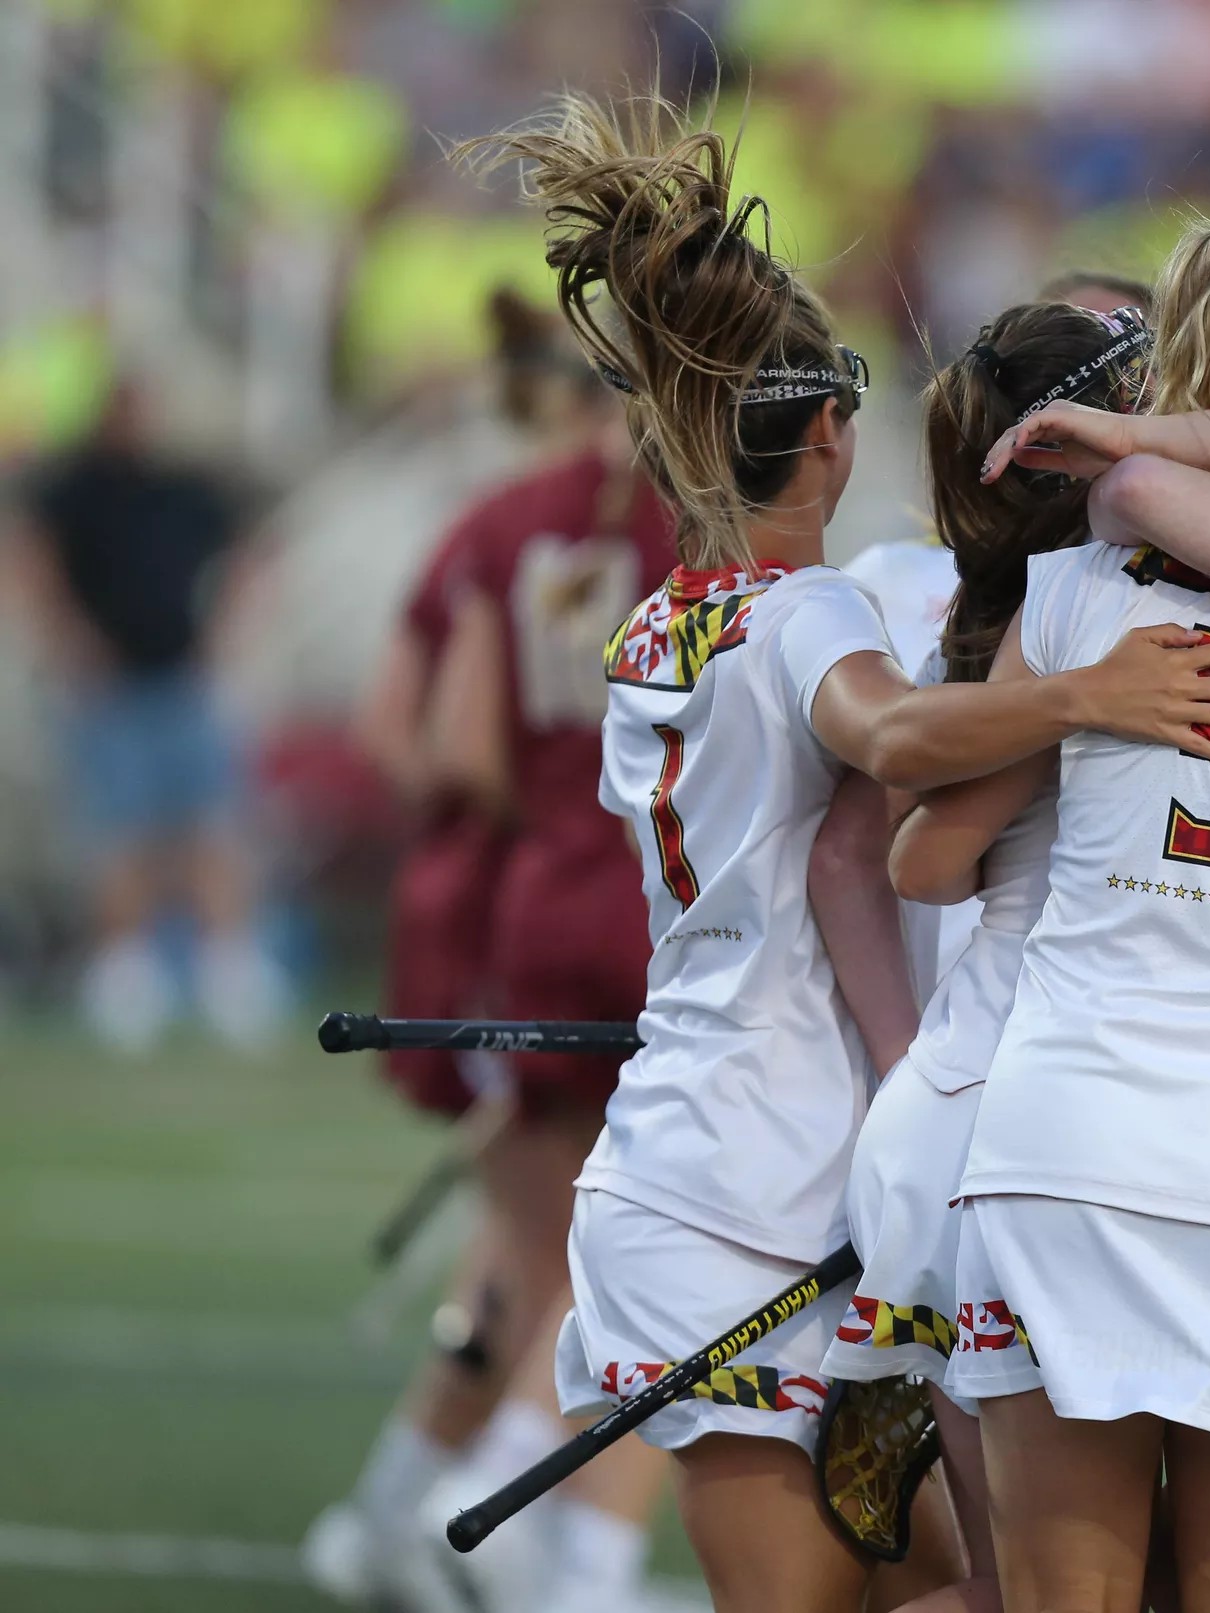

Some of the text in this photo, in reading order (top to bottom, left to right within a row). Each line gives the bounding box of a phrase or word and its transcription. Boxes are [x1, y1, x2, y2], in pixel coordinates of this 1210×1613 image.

[756, 369, 819, 380] ARMOUR
[1016, 385, 1065, 424] MOUR
[1091, 340, 1131, 369] UNDER
[650, 723, 701, 915] 1
